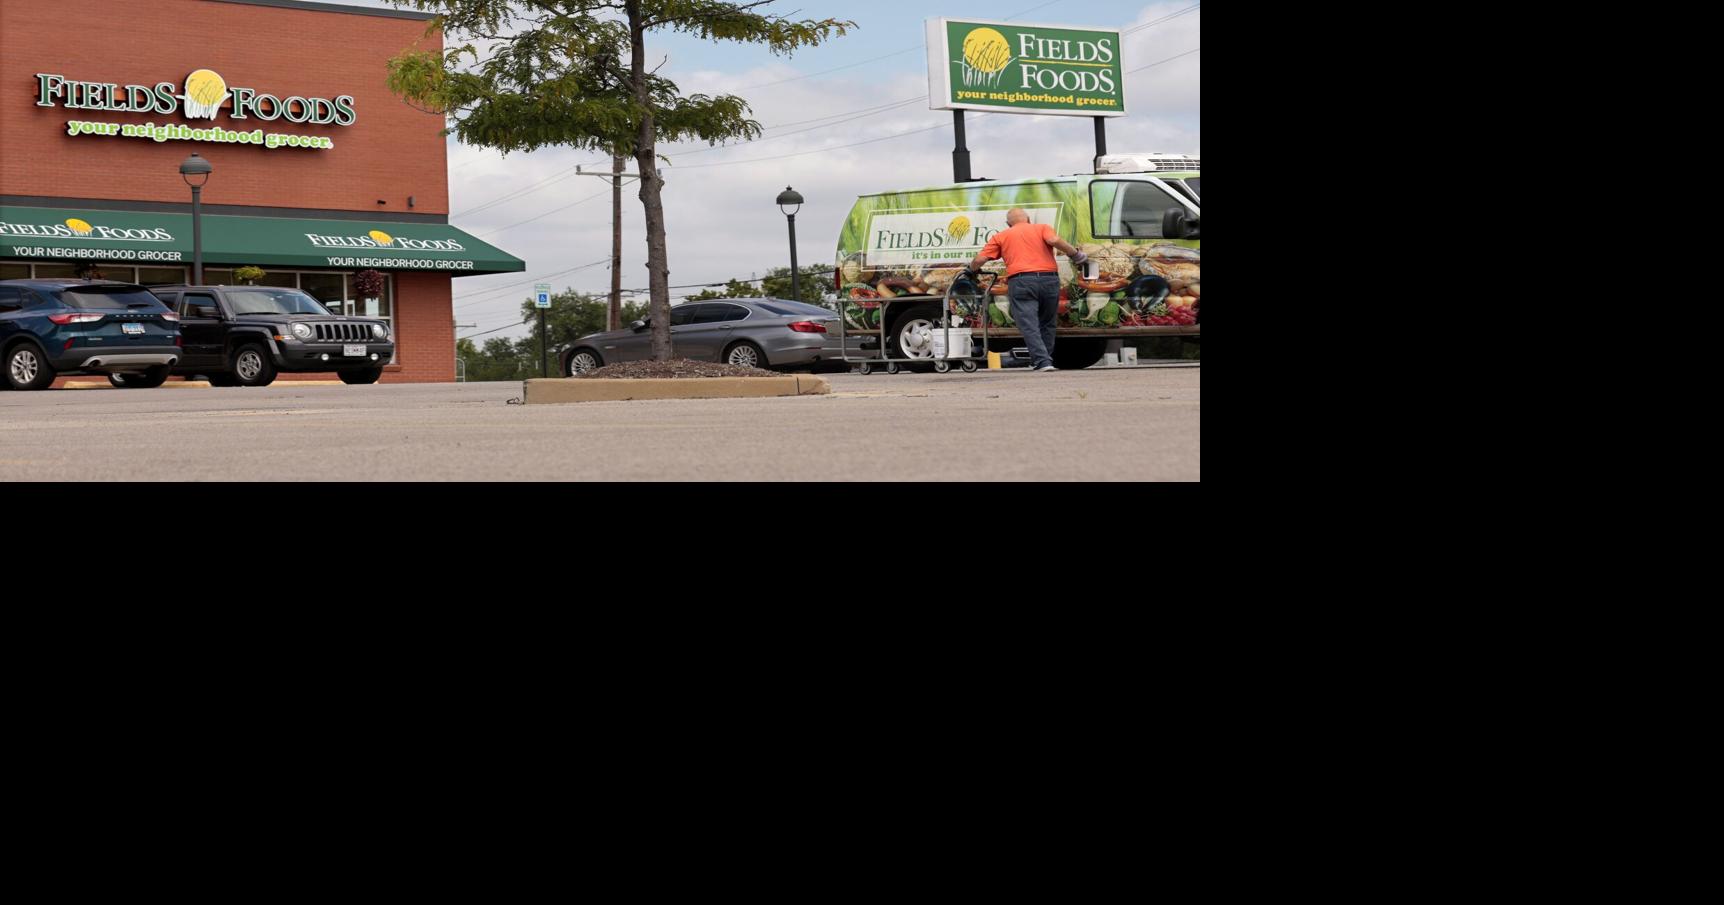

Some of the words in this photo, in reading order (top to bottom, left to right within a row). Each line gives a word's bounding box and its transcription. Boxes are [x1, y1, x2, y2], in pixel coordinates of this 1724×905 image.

[1017, 33, 1113, 63] FIELDS
[37, 73, 177, 115] FIELDS
[230, 87, 356, 126] FOODS
[957, 91, 987, 100] your
[989, 92, 1074, 104] neighborhood
[67, 120, 120, 136] your
[121, 122, 264, 144] neighborhood
[305, 233, 376, 247] FIELDS
[876, 227, 944, 249] FIELDS
[13, 246, 44, 257] YOUR
[46, 248, 136, 260] NEIGHBORHOOD
[138, 251, 182, 261] GROCER
[912, 251, 928, 260] it's
[931, 251, 941, 259] in
[943, 251, 963, 259] our
[327, 257, 355, 266] YOUR
[356, 257, 433, 268] NEIGHBORHOOD
[435, 260, 474, 269] GROCER
